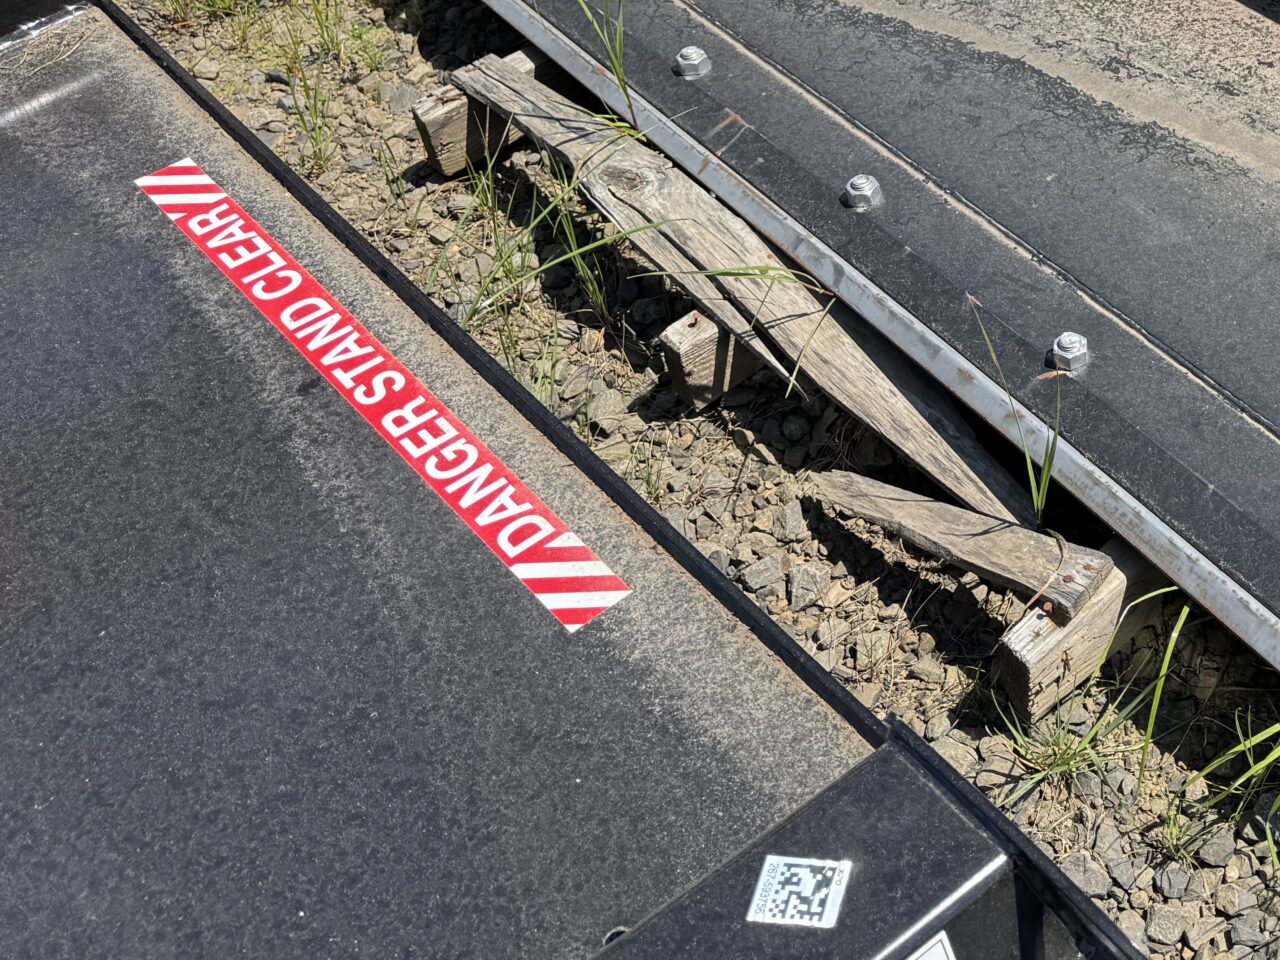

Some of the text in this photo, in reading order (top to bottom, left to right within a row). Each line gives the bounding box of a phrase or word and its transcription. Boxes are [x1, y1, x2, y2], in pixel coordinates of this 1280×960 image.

[187, 201, 557, 559] DANGER STAND CLEAR
